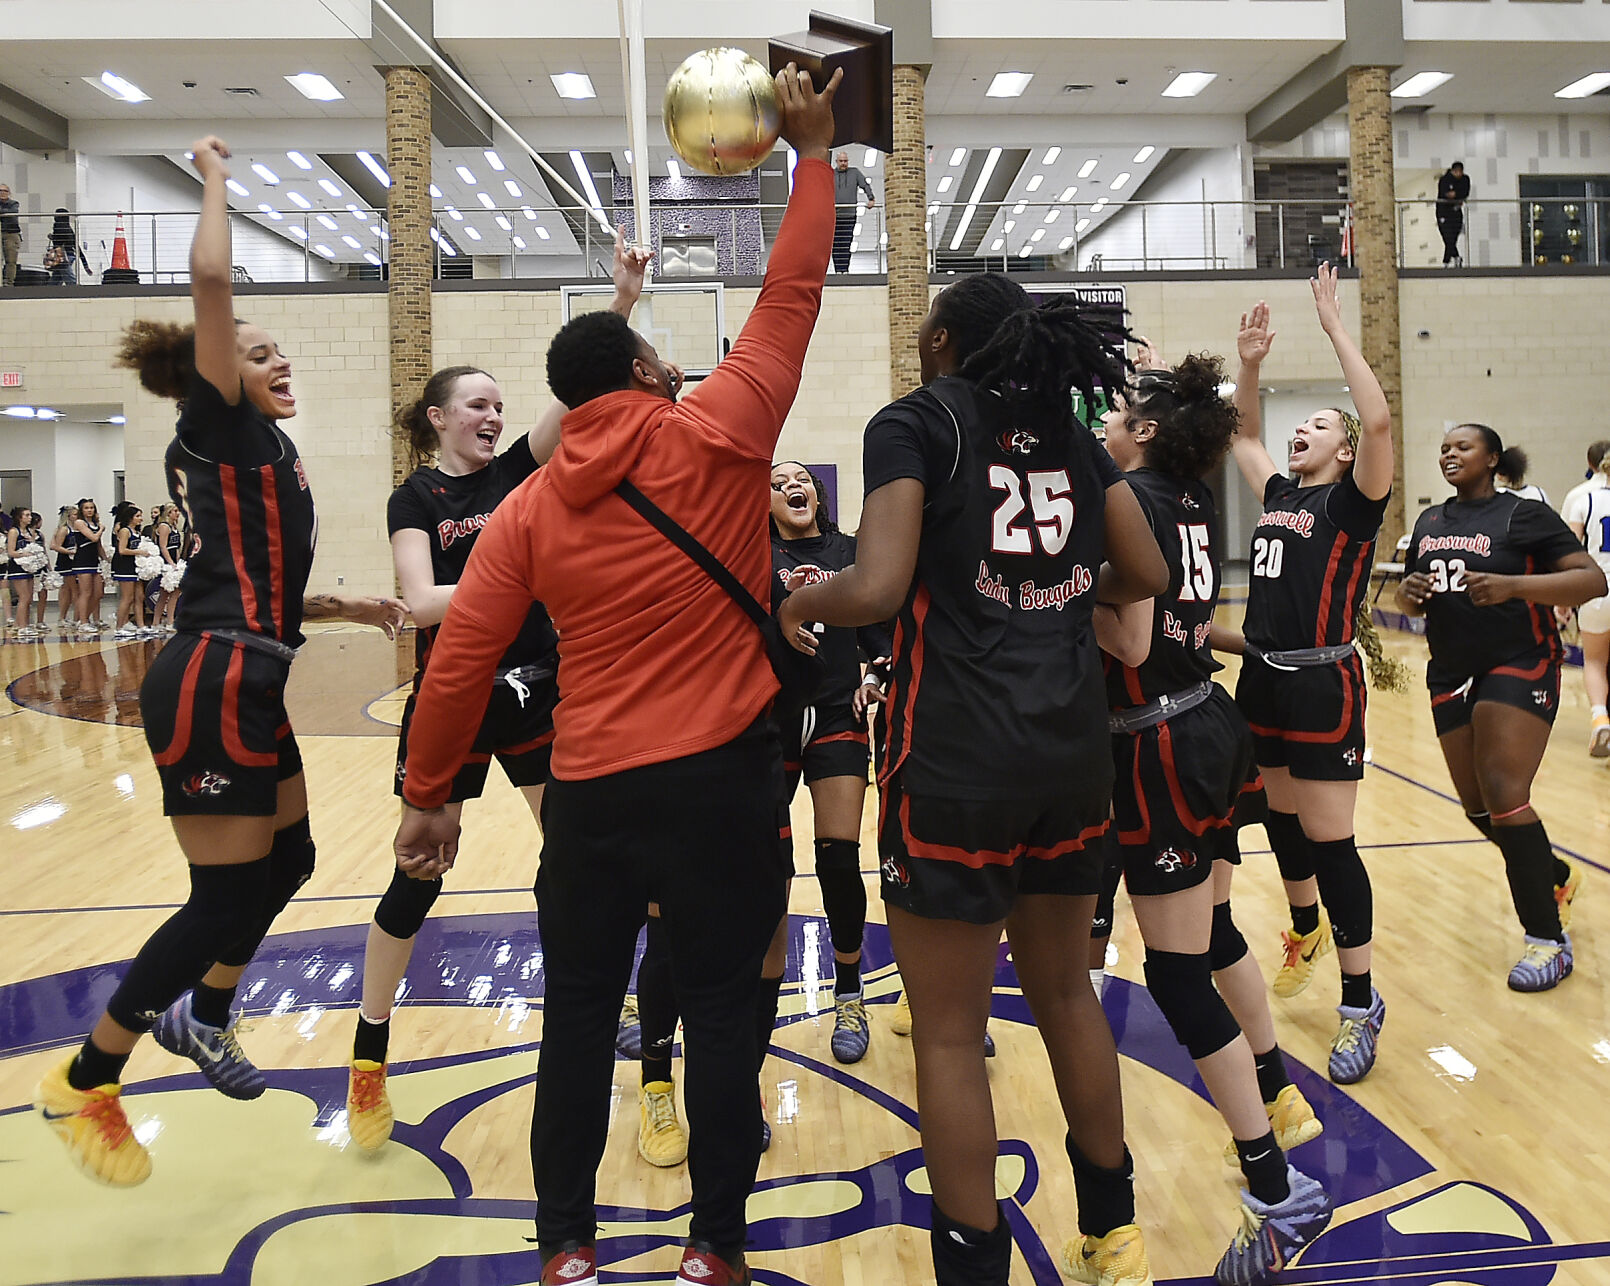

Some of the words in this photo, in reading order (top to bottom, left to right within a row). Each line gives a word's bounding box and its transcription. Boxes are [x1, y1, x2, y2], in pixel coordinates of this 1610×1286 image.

[1079, 290, 1122, 303] VISITOR
[3, 373, 19, 385] EXIT
[988, 463, 1076, 557] 25
[437, 512, 492, 551] Bras
[1417, 533, 1491, 559] Braswell
[1176, 522, 1215, 602] 15
[1253, 537, 1284, 579] 20
[1429, 558, 1468, 593] 32
[975, 559, 1013, 609] Lady
[1019, 564, 1093, 611] Bengals
